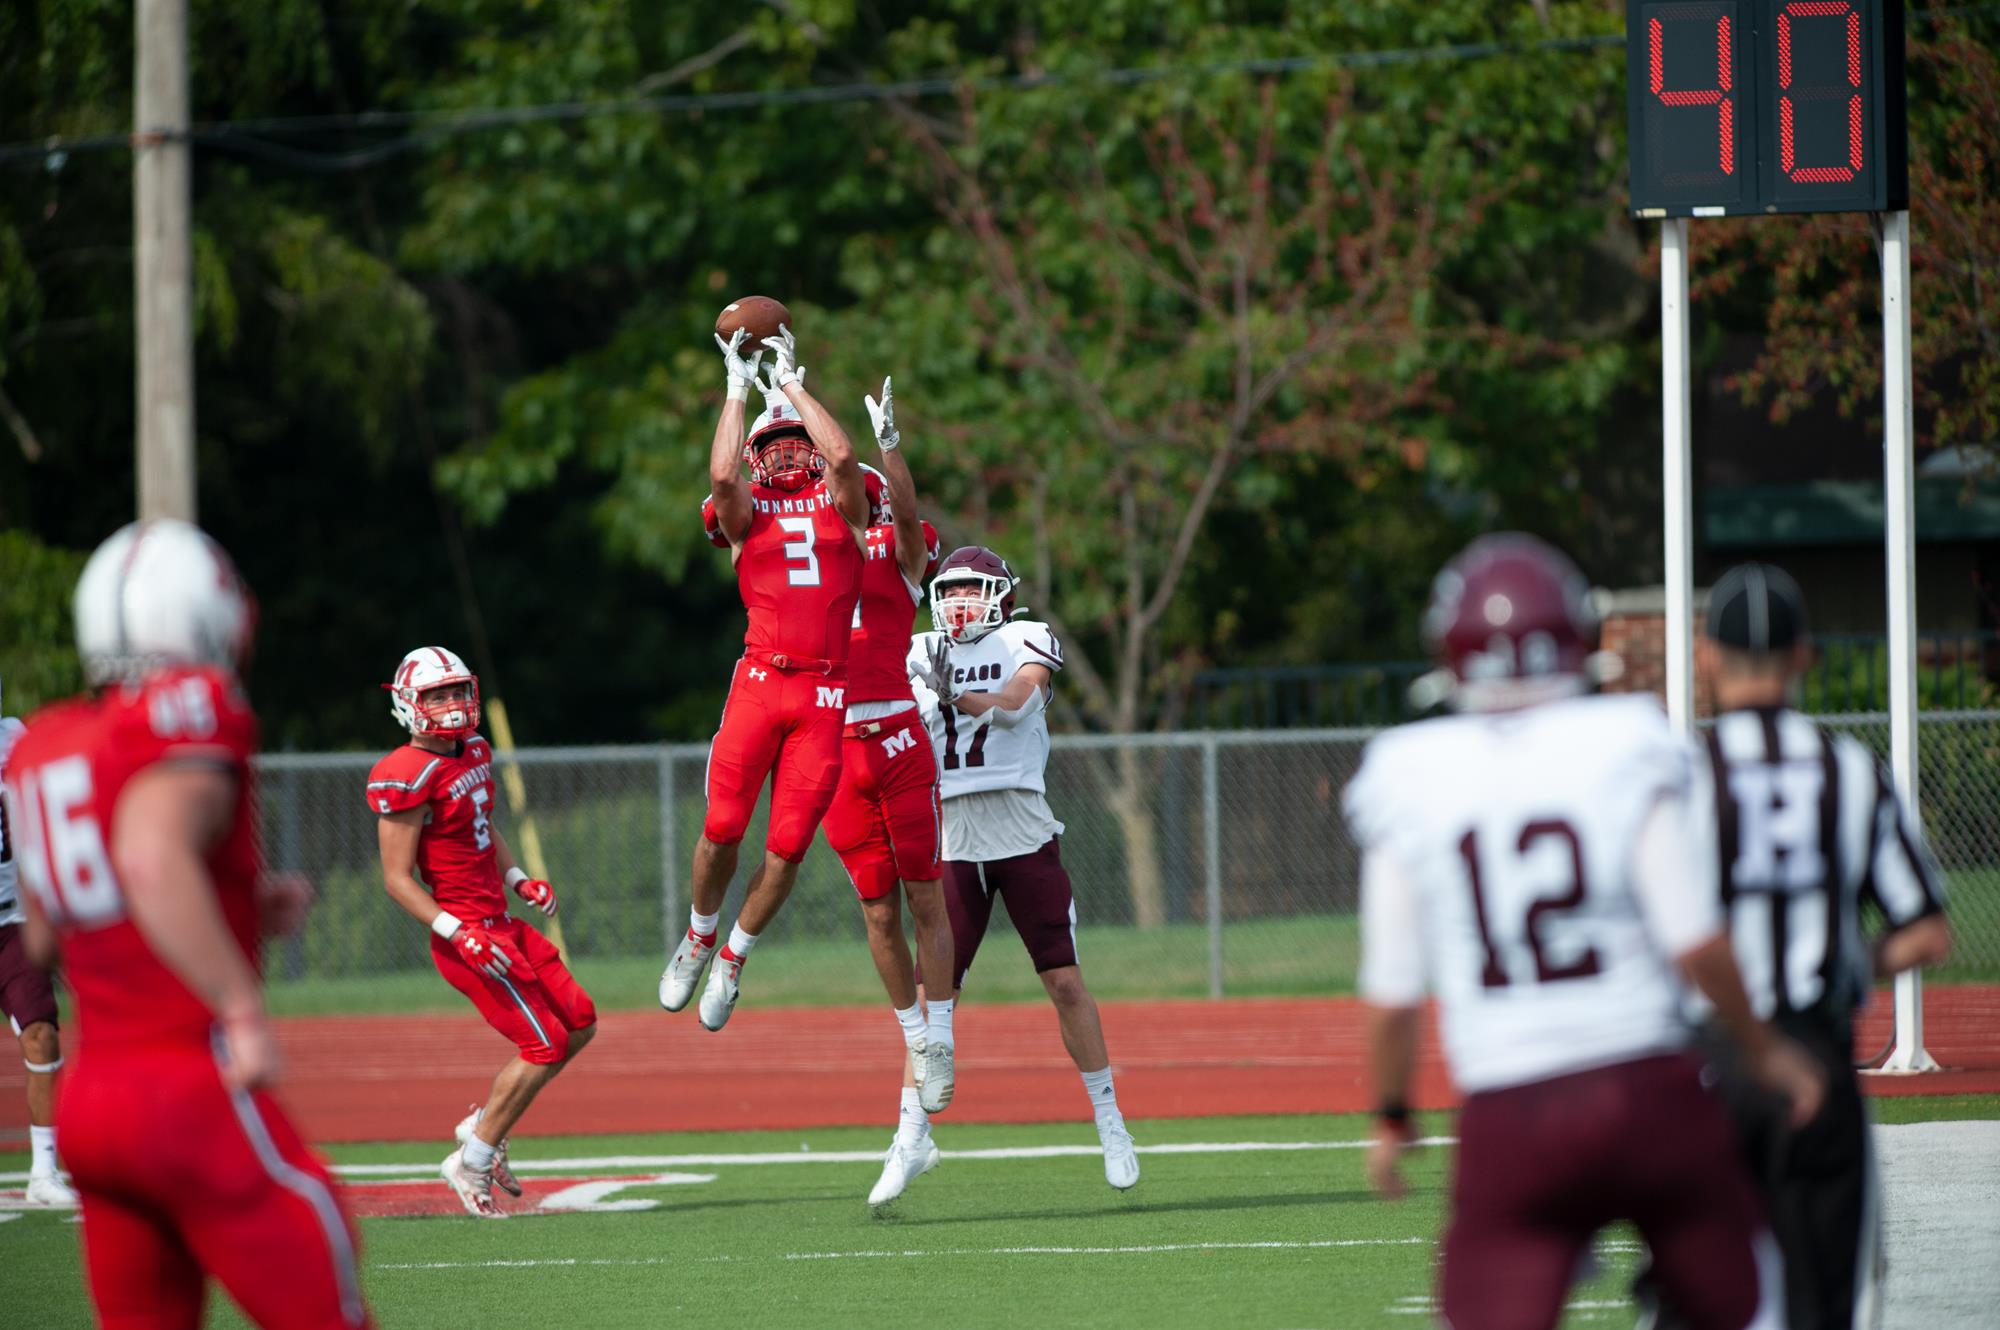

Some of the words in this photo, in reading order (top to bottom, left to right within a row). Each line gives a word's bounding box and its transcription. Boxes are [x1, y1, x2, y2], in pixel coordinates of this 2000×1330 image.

[1649, 1, 1863, 183] 40
[777, 516, 822, 588] 3
[816, 686, 844, 709] M
[881, 728, 918, 759] M
[1458, 817, 1602, 988] 12
